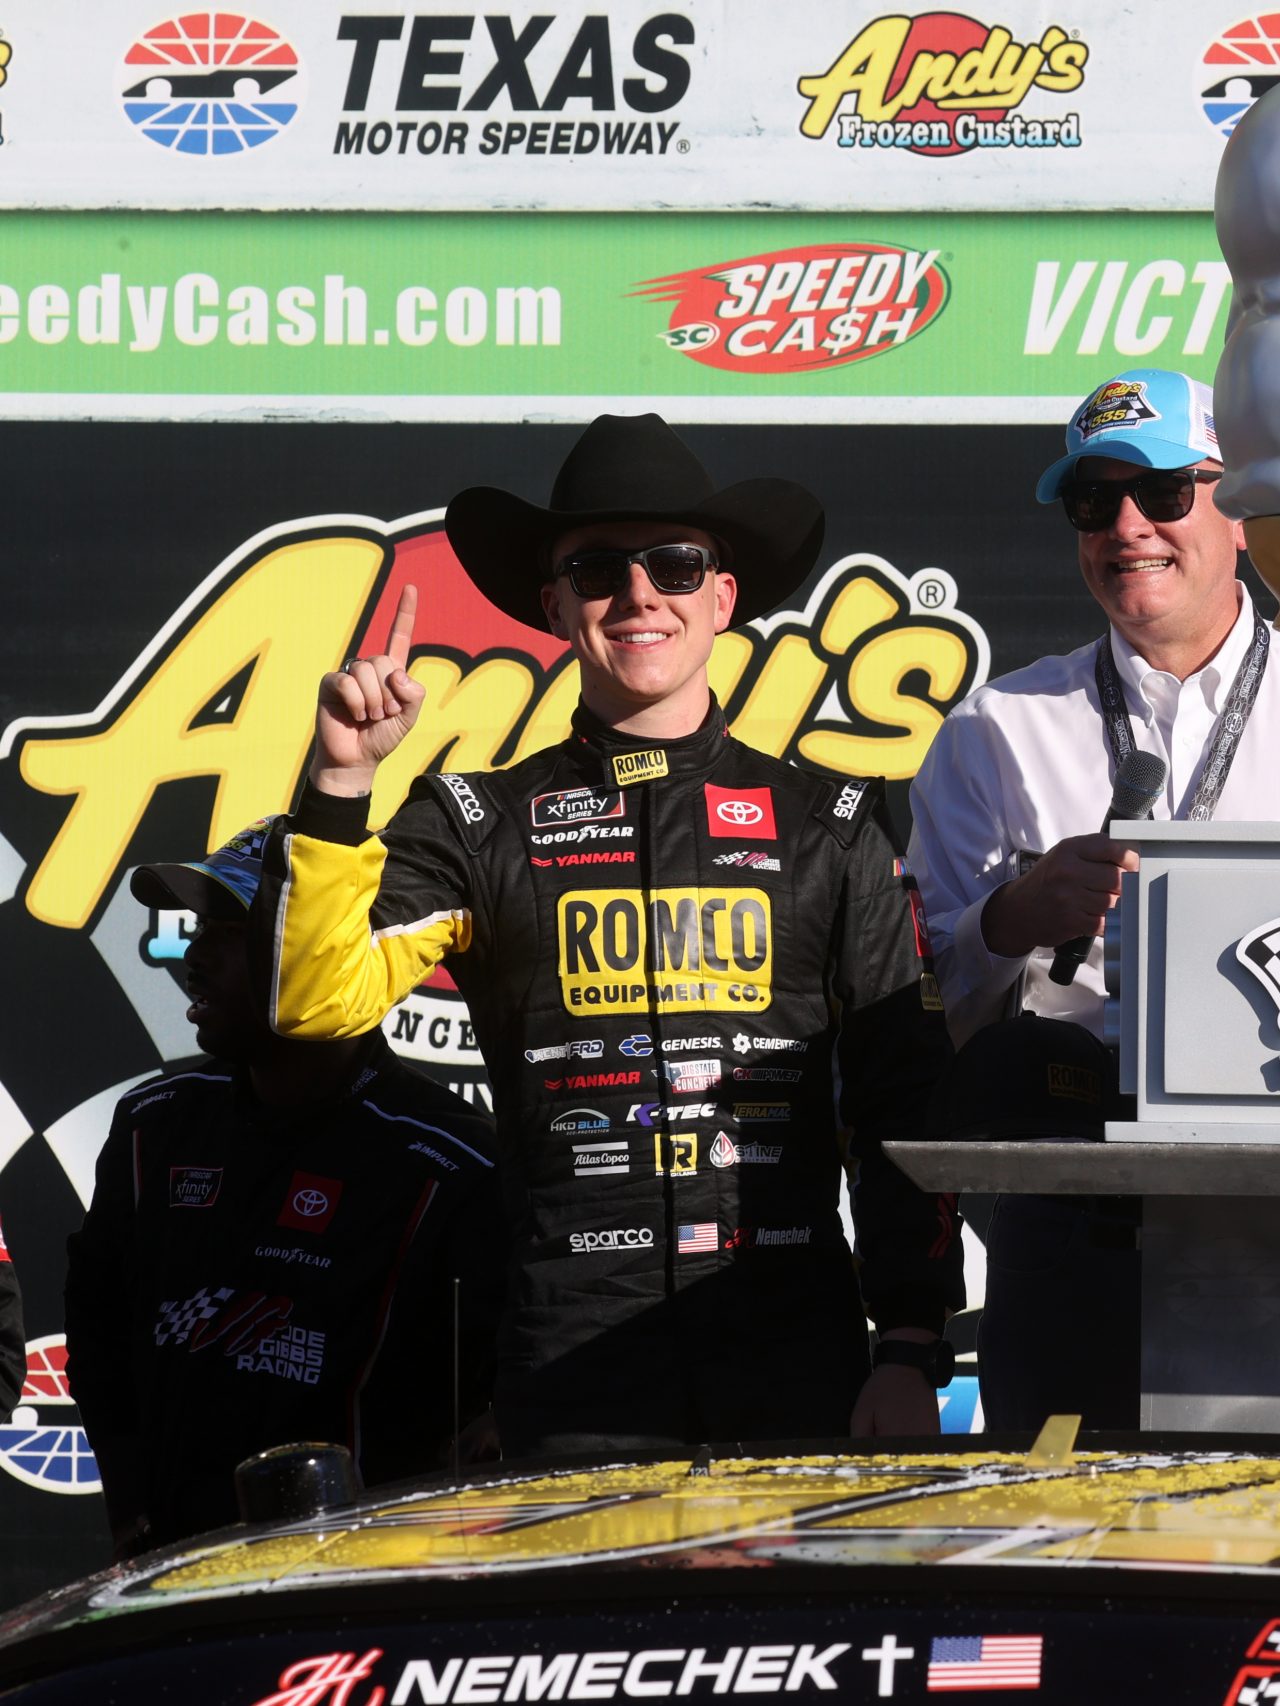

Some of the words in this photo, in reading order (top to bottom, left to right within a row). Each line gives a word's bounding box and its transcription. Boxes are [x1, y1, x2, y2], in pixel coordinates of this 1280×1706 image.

[335, 14, 695, 113] TEXAS
[797, 14, 1089, 138] Andy's
[333, 121, 467, 155] MOTOR
[479, 121, 679, 155] SPEEDWAY
[837, 114, 950, 149] Frozen
[957, 112, 1081, 148] Custard
[714, 249, 942, 319] SPEEDY
[1023, 260, 1234, 356] VICT
[1090, 409, 1127, 429] 335
[20, 535, 969, 928] Any's
[616, 750, 665, 776] ROMCO
[619, 771, 655, 783] EQUIPMENT
[436, 773, 486, 825] sparco
[547, 797, 609, 817] xfinity
[567, 810, 593, 820] SERIES
[530, 825, 634, 845] GOODYEAR
[555, 851, 637, 867] YANMAR
[564, 897, 768, 975] ROMCO
[569, 983, 719, 1006] EQUIPMENT
[727, 983, 765, 1003] CO.
[391, 1009, 480, 1052] NCE
[565, 1071, 642, 1089] YANMAR
[675, 1075, 717, 1092] CONCRETE
[577, 1119, 610, 1130] BLUE
[625, 1103, 717, 1127] K-TEC
[574, 1154, 600, 1166] Atlas
[600, 1152, 630, 1166] Copco
[569, 1228, 654, 1253] sparco
[754, 1226, 813, 1246] Nemechek
[254, 1245, 334, 1270] GOODYEAR
[280, 1324, 327, 1350] JOE
[259, 1338, 325, 1368] GIBBS
[235, 1353, 321, 1386] RACING
[391, 1642, 852, 1706] NEMECHEK
